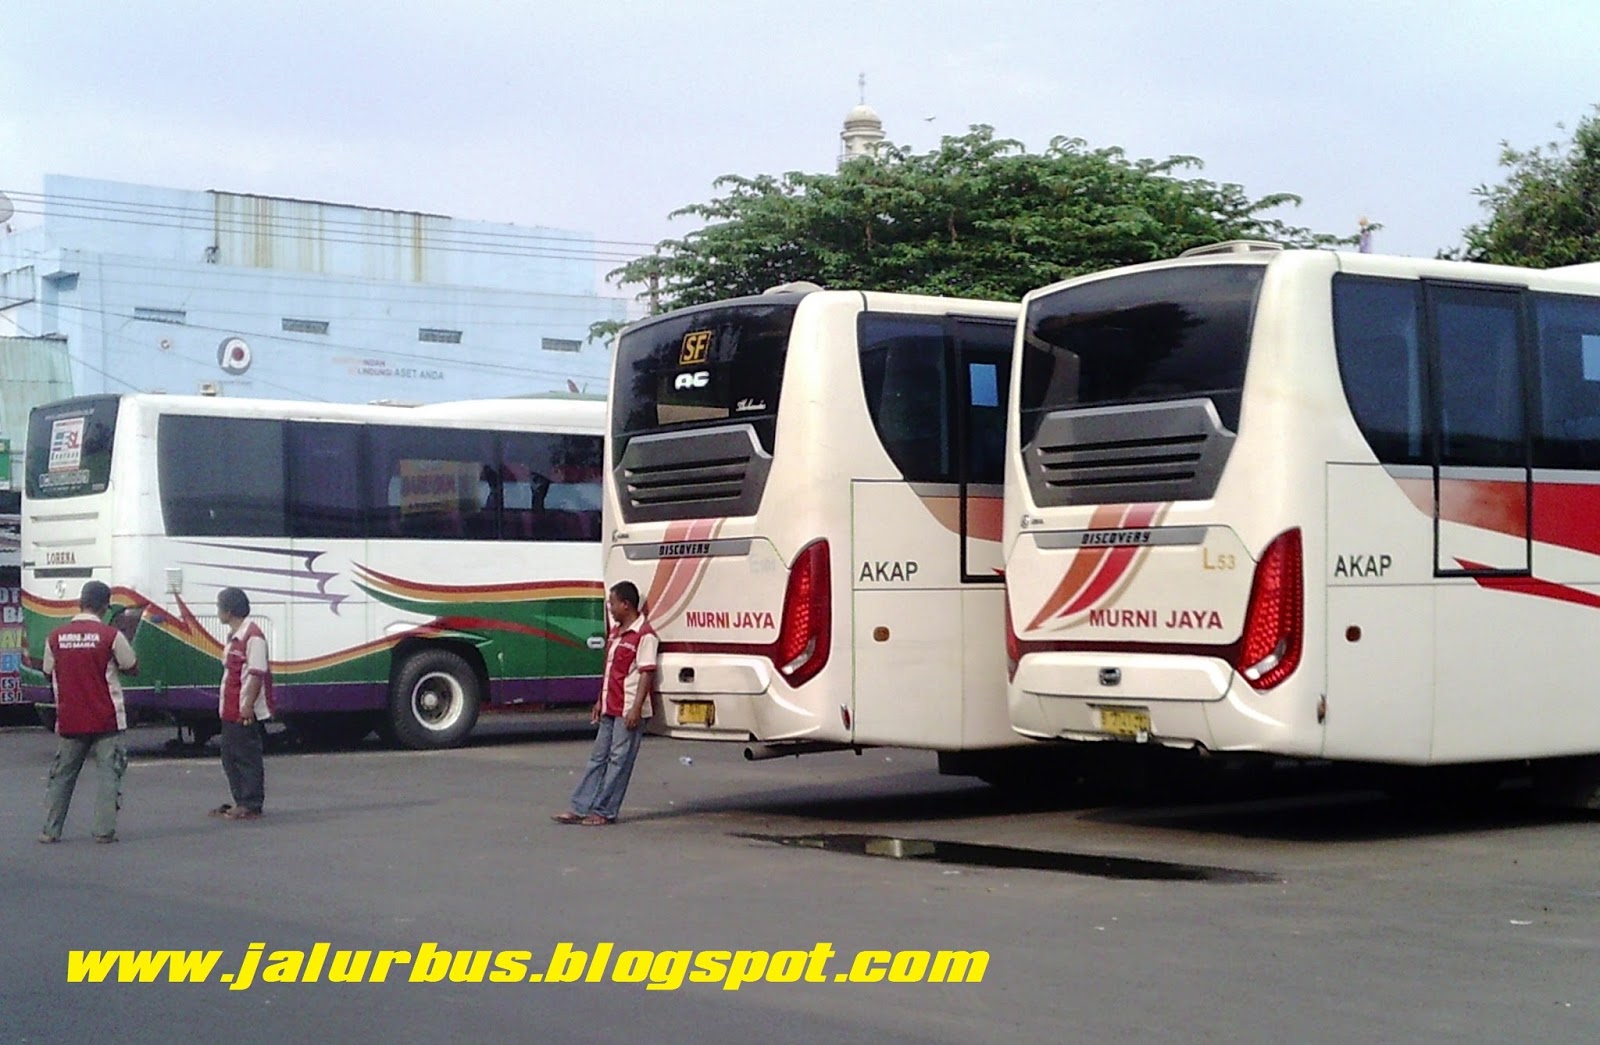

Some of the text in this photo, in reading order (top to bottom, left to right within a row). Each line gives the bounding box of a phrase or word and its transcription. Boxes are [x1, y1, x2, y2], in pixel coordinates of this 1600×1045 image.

[683, 336, 707, 361] SF
[395, 368, 417, 379] ASET
[420, 371, 445, 380] ANDA
[1081, 531, 1152, 545] DISCOVERY
[46, 551, 76, 565] LORENA
[658, 543, 710, 556] DISCOVERY
[859, 561, 919, 582] AKAP
[1334, 555, 1392, 577] AKAP
[685, 611, 776, 630] MURNI JAYA
[1089, 609, 1224, 630] MURNI JAYA
